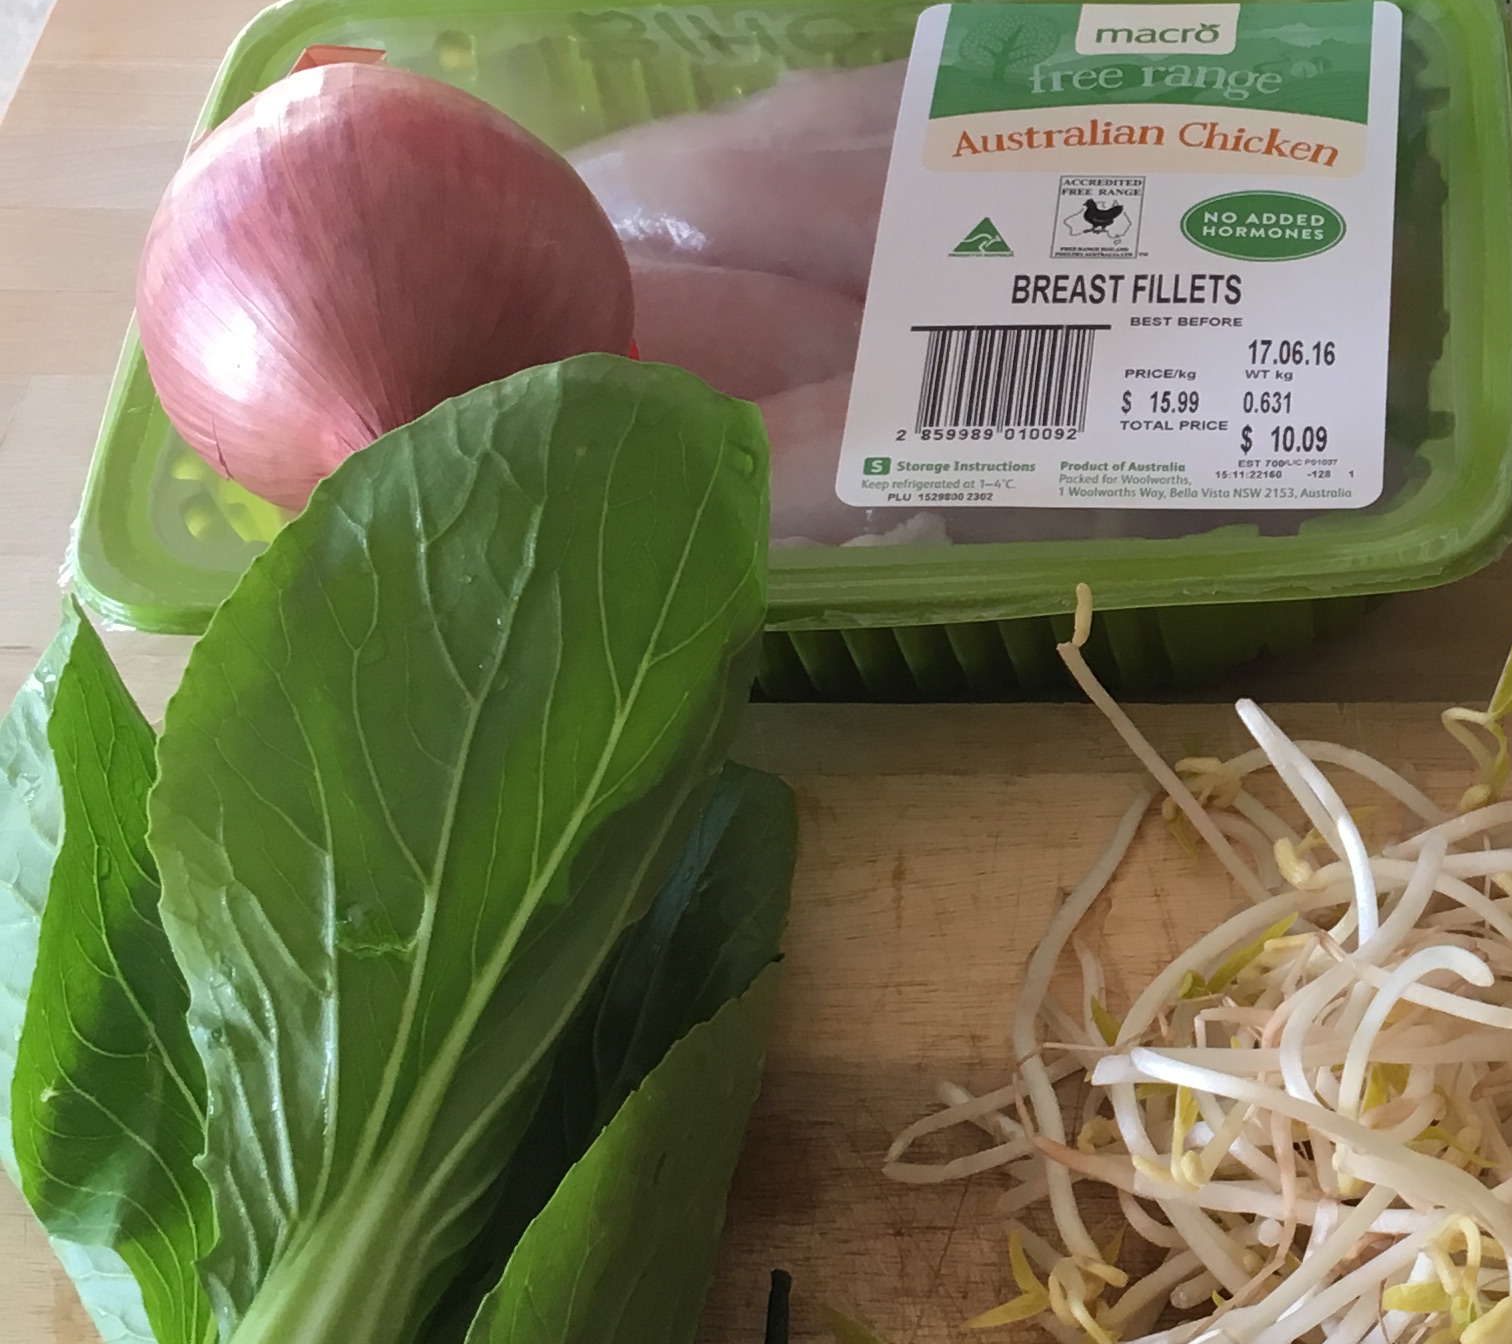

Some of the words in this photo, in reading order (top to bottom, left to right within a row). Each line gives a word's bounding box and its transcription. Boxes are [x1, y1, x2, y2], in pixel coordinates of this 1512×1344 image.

[1029, 62, 1123, 95] free
[1141, 64, 1283, 101] range
[952, 118, 1165, 158] Australian
[1178, 121, 1340, 168] Chicken
[1062, 179, 1143, 187] ACCREDITED
[1061, 188, 1093, 196] FREE
[1099, 188, 1142, 196] RANGE
[1203, 211, 1235, 226] NO
[1245, 211, 1326, 227] ADDED
[1202, 224, 1324, 241] HORMONES
[1012, 275, 1125, 304] BREAST
[1132, 274, 1242, 305] FILLETS
[1130, 317, 1172, 327] BEST
[1178, 317, 1243, 327] BEFORE
[1248, 340, 1336, 366] 17.06.16
[1125, 369, 1197, 381] PRICE/kg
[1246, 370, 1270, 379] WT
[1276, 370, 1293, 382] kg
[1121, 390, 1132, 414] $
[1150, 391, 1199, 413] 15.99
[1243, 392, 1292, 414] 0.631
[1120, 421, 1174, 431] TOTAL
[1179, 421, 1229, 431] PRICE
[896, 430, 907, 441] 2
[920, 429, 993, 441] 859989
[1004, 429, 1078, 441] 010092
[1240, 424, 1253, 455] $
[1271, 426, 1328, 453] 10.09
[897, 461, 950, 474] Storage
[954, 461, 1036, 473] Instructions
[1060, 461, 1109, 471] Product
[1112, 461, 1126, 471] of
[1127, 462, 1186, 472] Australia
[1238, 459, 1261, 468] EST
[861, 479, 889, 492] Keep
[892, 479, 960, 492] refrigerated
[963, 480, 976, 489] at
[1059, 474, 1098, 484] Packed
[1102, 474, 1118, 484] for
[1121, 475, 1192, 486] Woolworths,
[887, 493, 911, 502] PLU
[1069, 487, 1136, 498] Woolworths
[1140, 488, 1166, 500] Way,
[1170, 488, 1198, 498] Bella
[1201, 488, 1230, 498] Vista
[1233, 488, 1262, 498] NSW
[1265, 488, 1297, 499] 2153,
[1300, 488, 1352, 498] Australia
